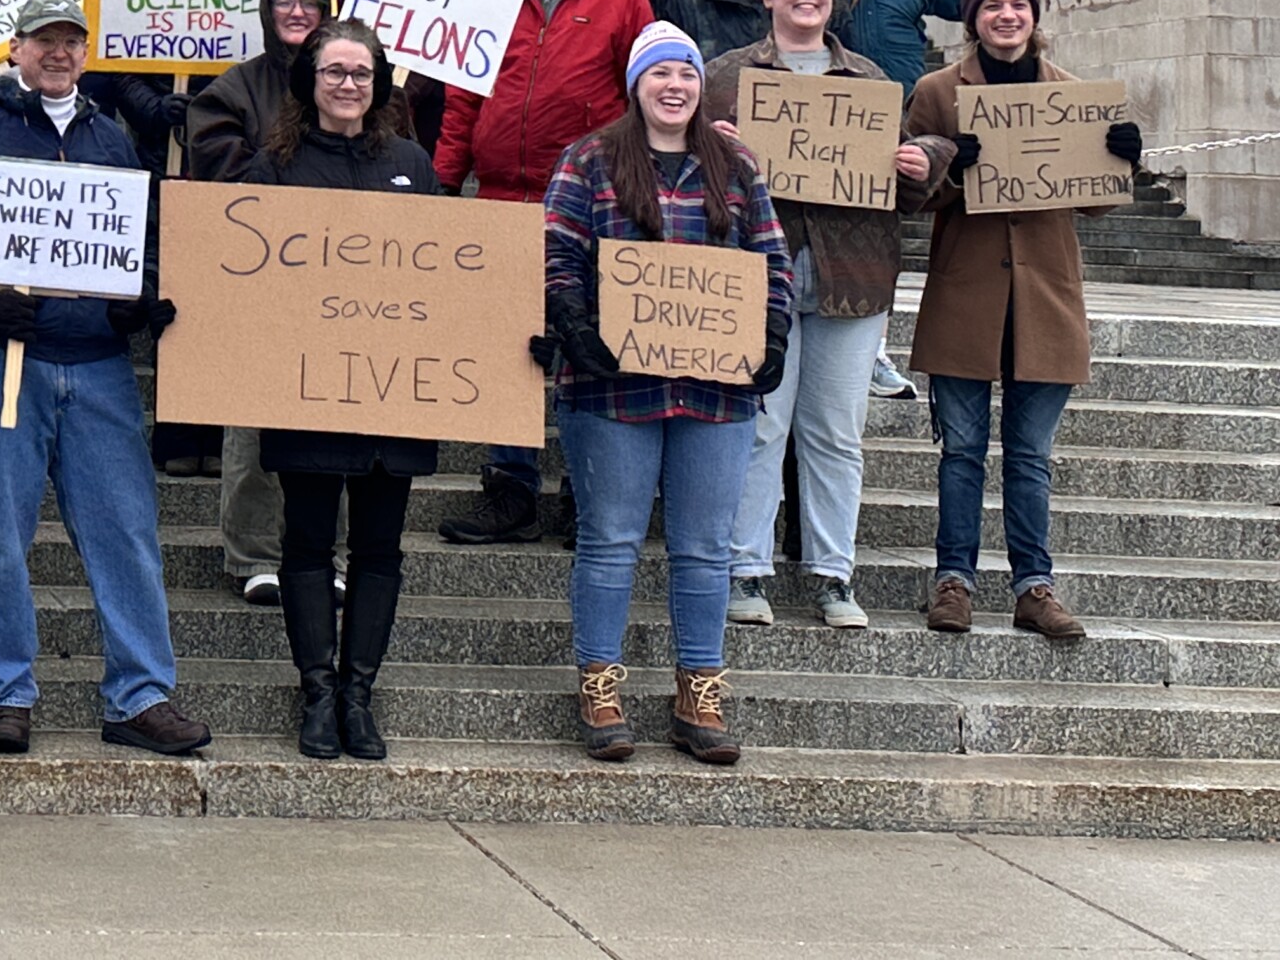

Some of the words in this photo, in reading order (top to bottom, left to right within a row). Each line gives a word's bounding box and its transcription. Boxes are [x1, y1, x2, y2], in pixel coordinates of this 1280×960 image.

[146, 11, 174, 33] IS
[187, 10, 234, 32] FOR
[80, 181, 122, 211] IT'S
[832, 167, 891, 208] NIH
[87, 212, 133, 236] THE
[220, 196, 486, 276] Science
[4, 233, 46, 265] ARE
[610, 246, 744, 302] SCIENCE
[320, 294, 429, 322] saves
[631, 293, 739, 336] DRIVES
[617, 328, 754, 378] AMERICA
[299, 351, 481, 405] LIVES
